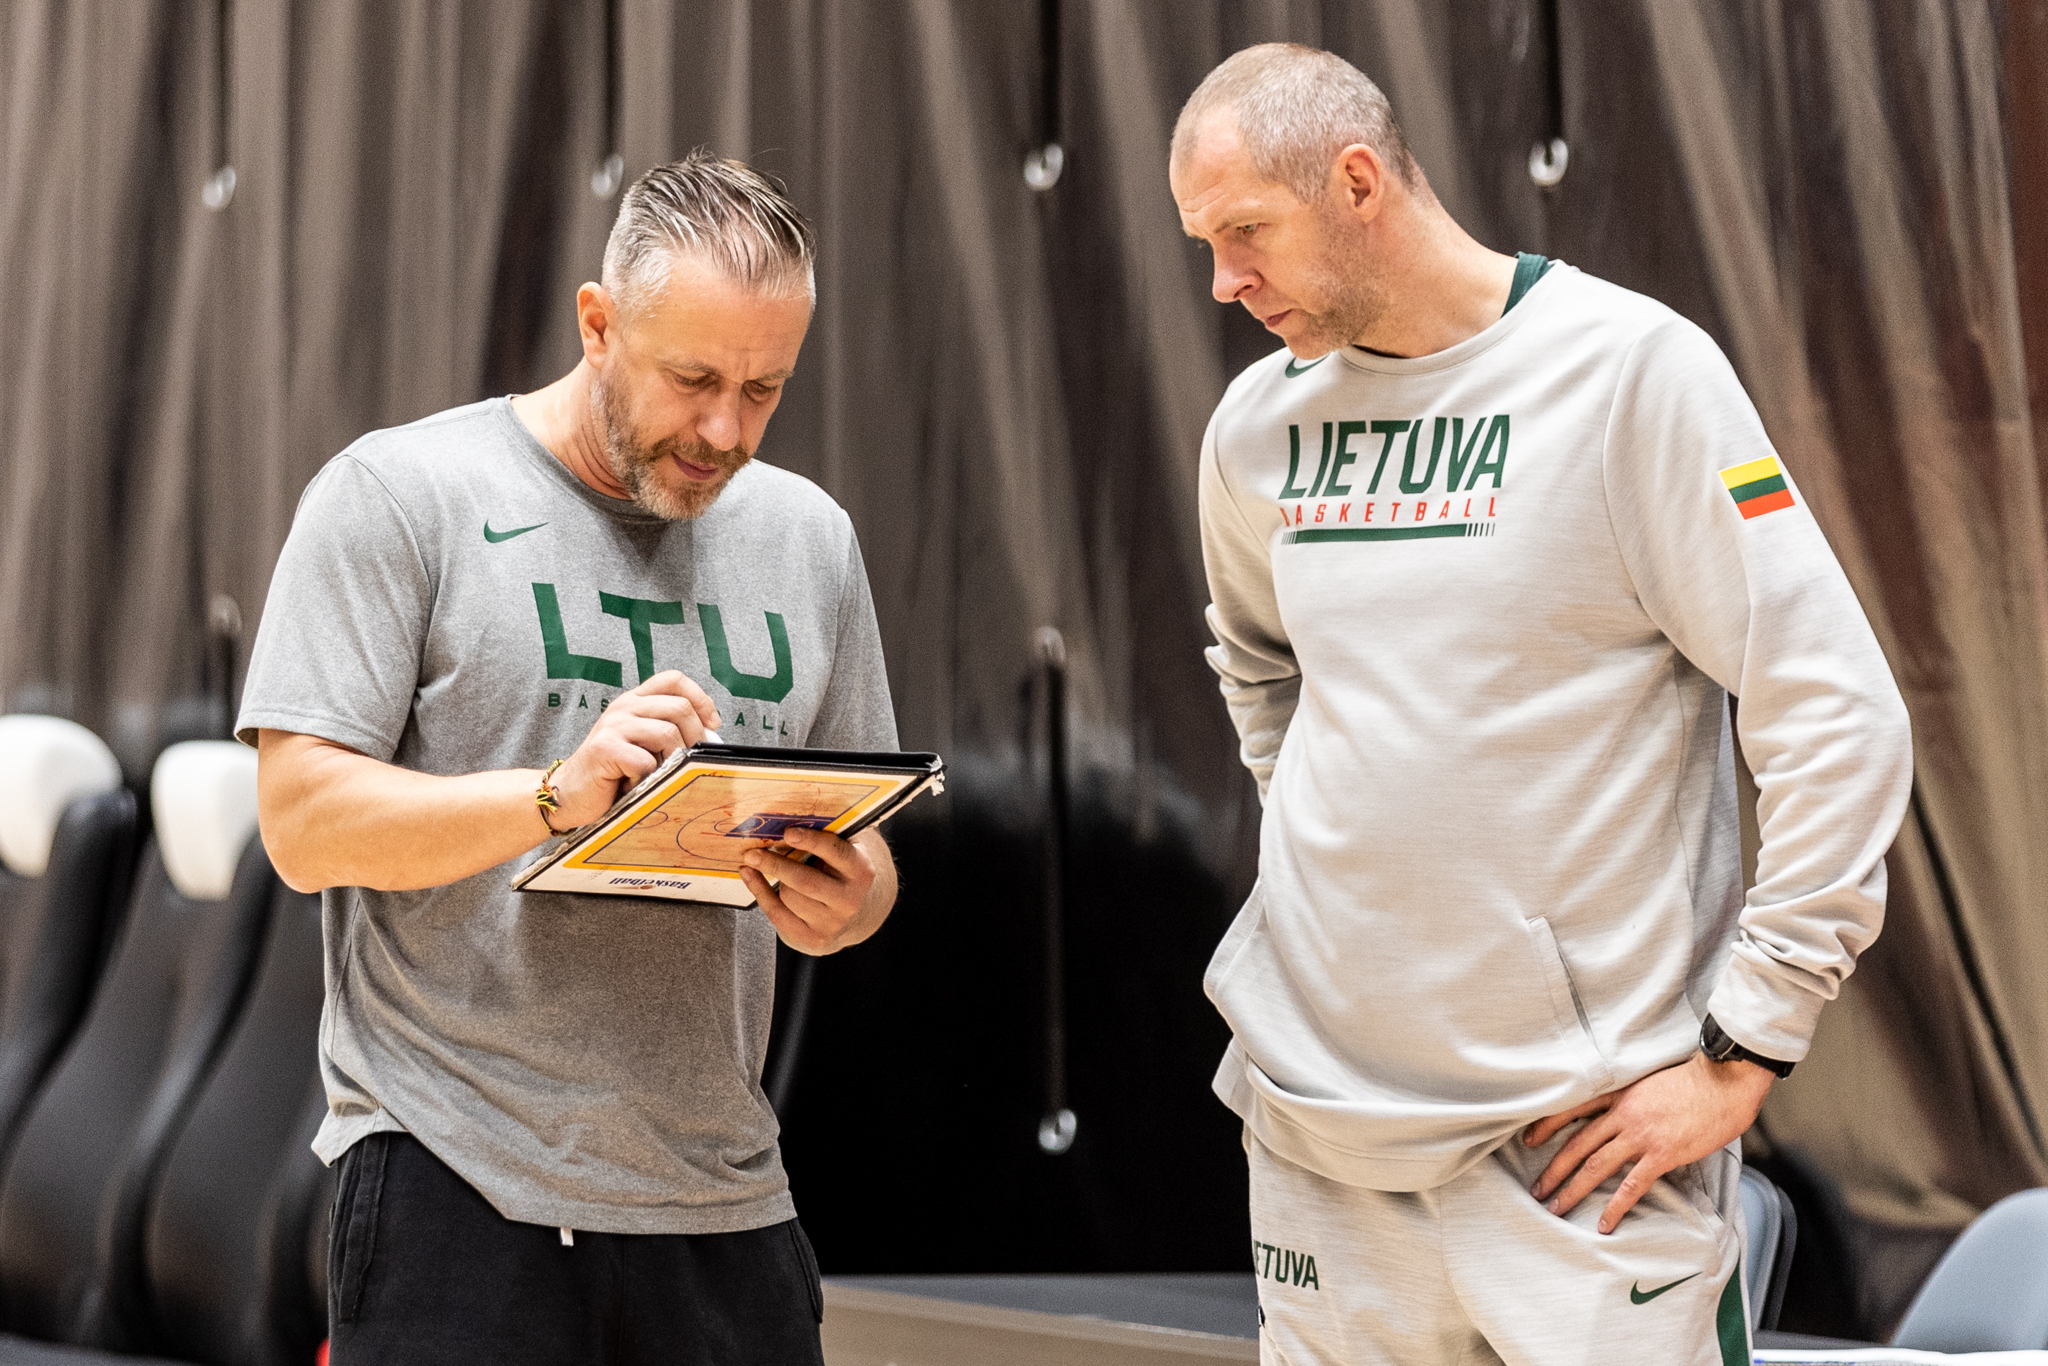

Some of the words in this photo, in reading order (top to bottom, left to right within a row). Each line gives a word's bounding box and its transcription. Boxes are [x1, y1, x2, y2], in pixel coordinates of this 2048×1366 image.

[1278, 414, 1510, 500] LIETUVA
[532, 582, 794, 704] LTU
[547, 692, 788, 736] BASALL
[608, 877, 692, 889] Basketball
